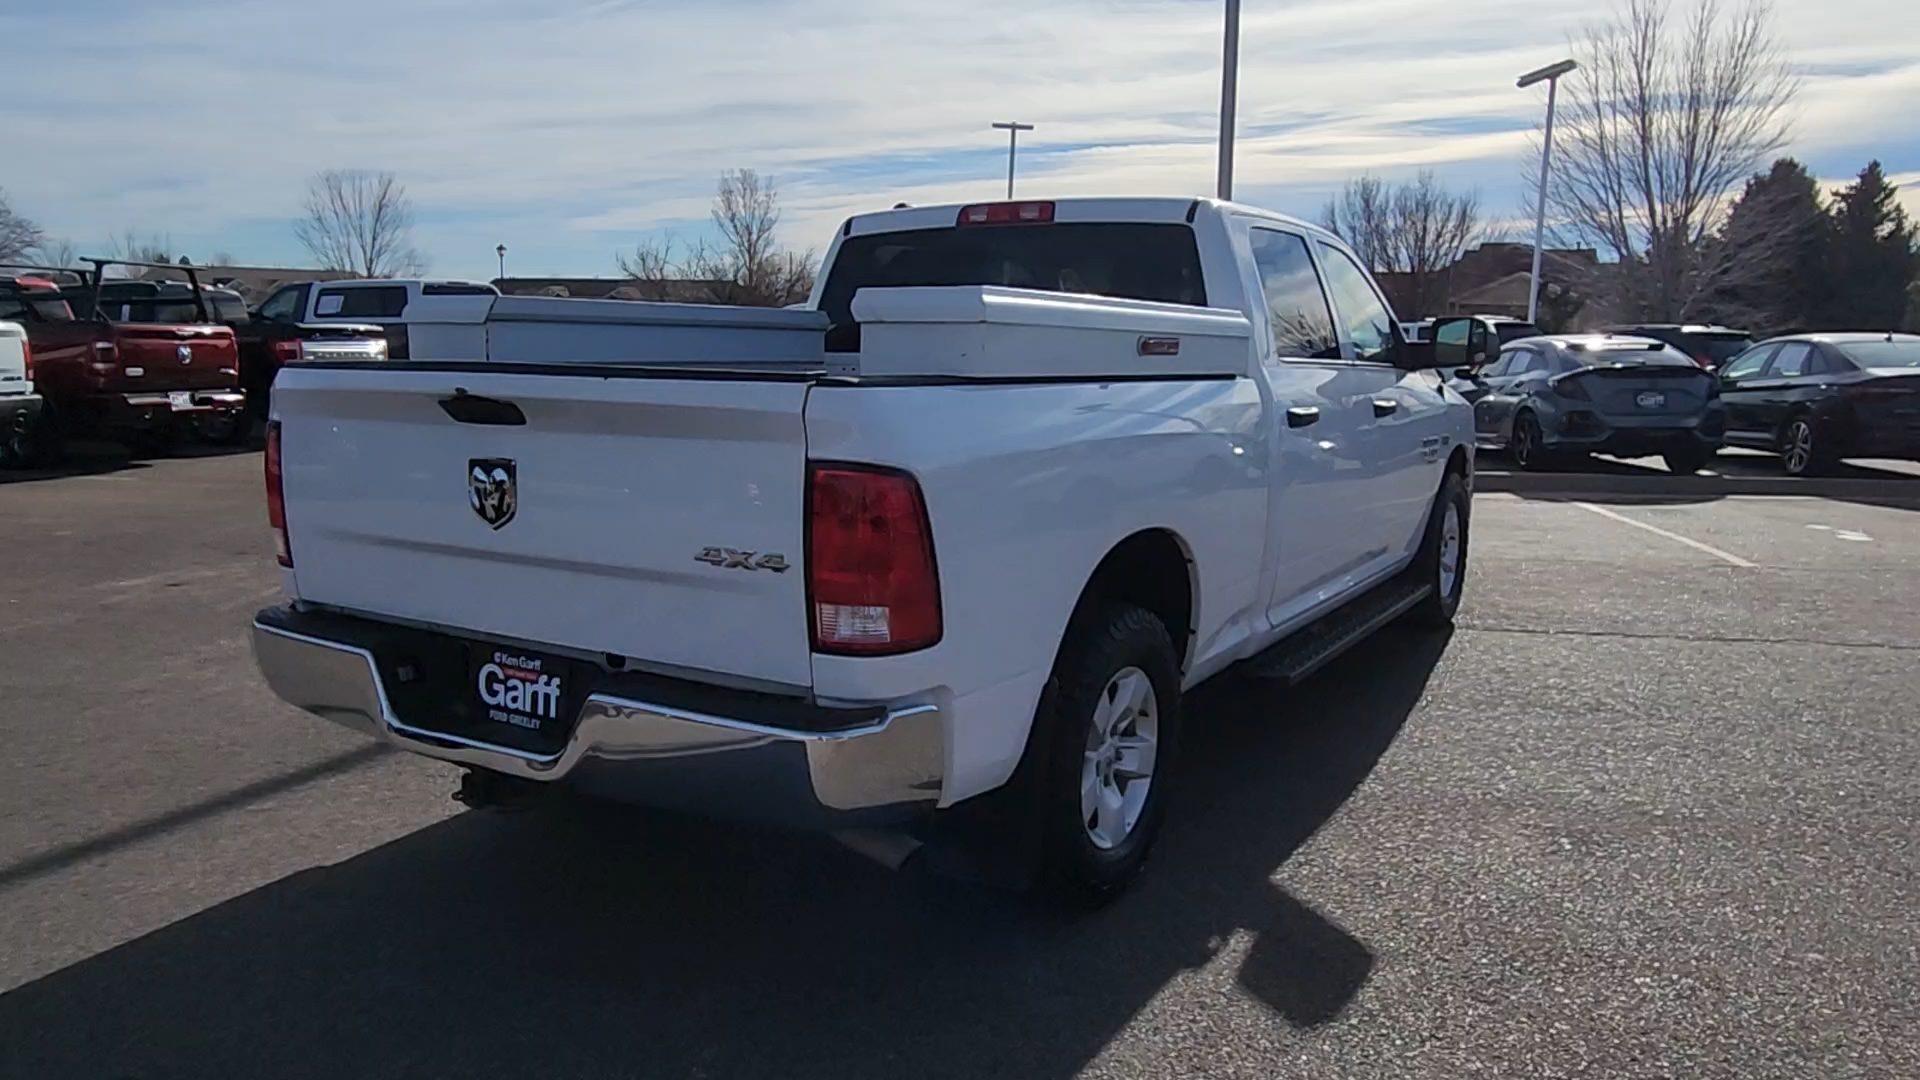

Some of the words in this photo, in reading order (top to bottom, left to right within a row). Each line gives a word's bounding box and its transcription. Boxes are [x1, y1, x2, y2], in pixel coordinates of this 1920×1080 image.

[501, 652, 519, 667] Ken
[519, 656, 541, 670] Garff
[479, 663, 561, 719] Garff
